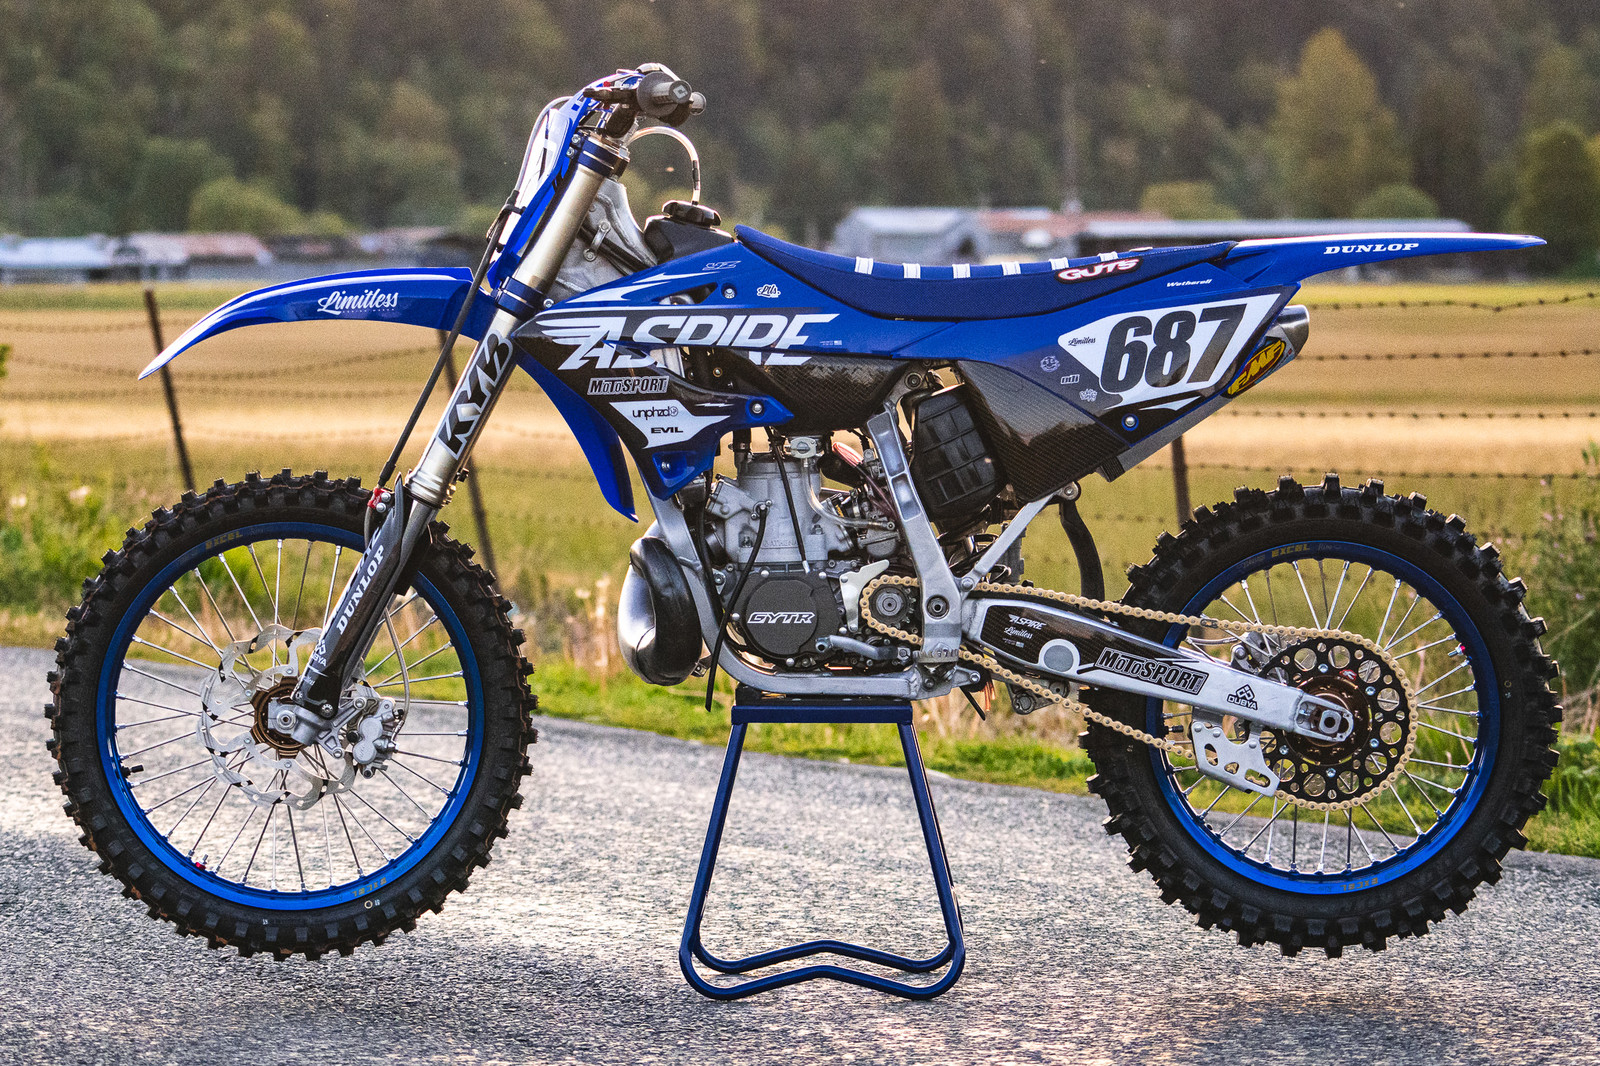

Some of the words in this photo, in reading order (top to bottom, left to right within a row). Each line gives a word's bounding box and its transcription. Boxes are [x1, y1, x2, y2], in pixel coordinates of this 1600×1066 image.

[1323, 243, 1419, 255] DUNLOP
[1058, 258, 1140, 281] GUTS
[316, 288, 399, 315] Limitless
[1099, 303, 1248, 394] 687
[1227, 340, 1283, 396] FMF
[651, 426, 684, 434] EVIL
[1271, 543, 1311, 558] EXCEL
[335, 544, 384, 635] DUNLOP
[747, 611, 816, 624] GYTR
[1008, 613, 1047, 630] ASPIRE
[1227, 694, 1258, 711] DUBYA
